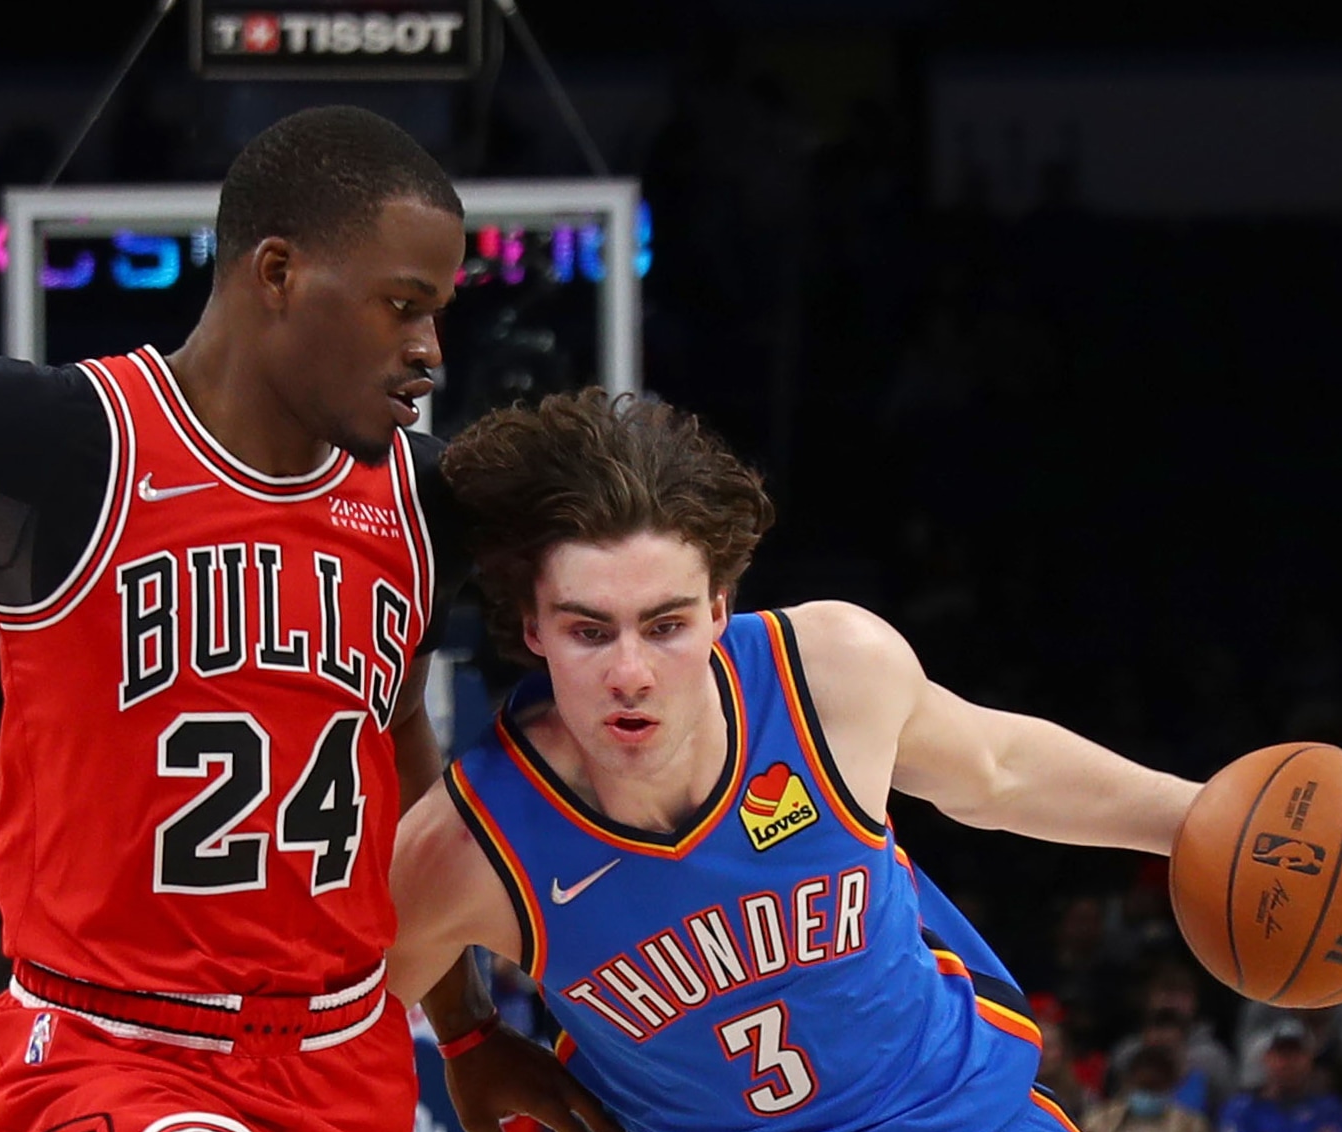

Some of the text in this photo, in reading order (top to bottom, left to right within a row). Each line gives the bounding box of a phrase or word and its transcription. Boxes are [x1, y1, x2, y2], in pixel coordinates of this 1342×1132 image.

[282, 12, 462, 53] TISSOT
[331, 515, 400, 539] EYEWEAR
[116, 542, 411, 733] BULLS
[153, 711, 367, 896] 24
[562, 867, 869, 1043] THUNDER
[714, 1000, 819, 1116] 3
